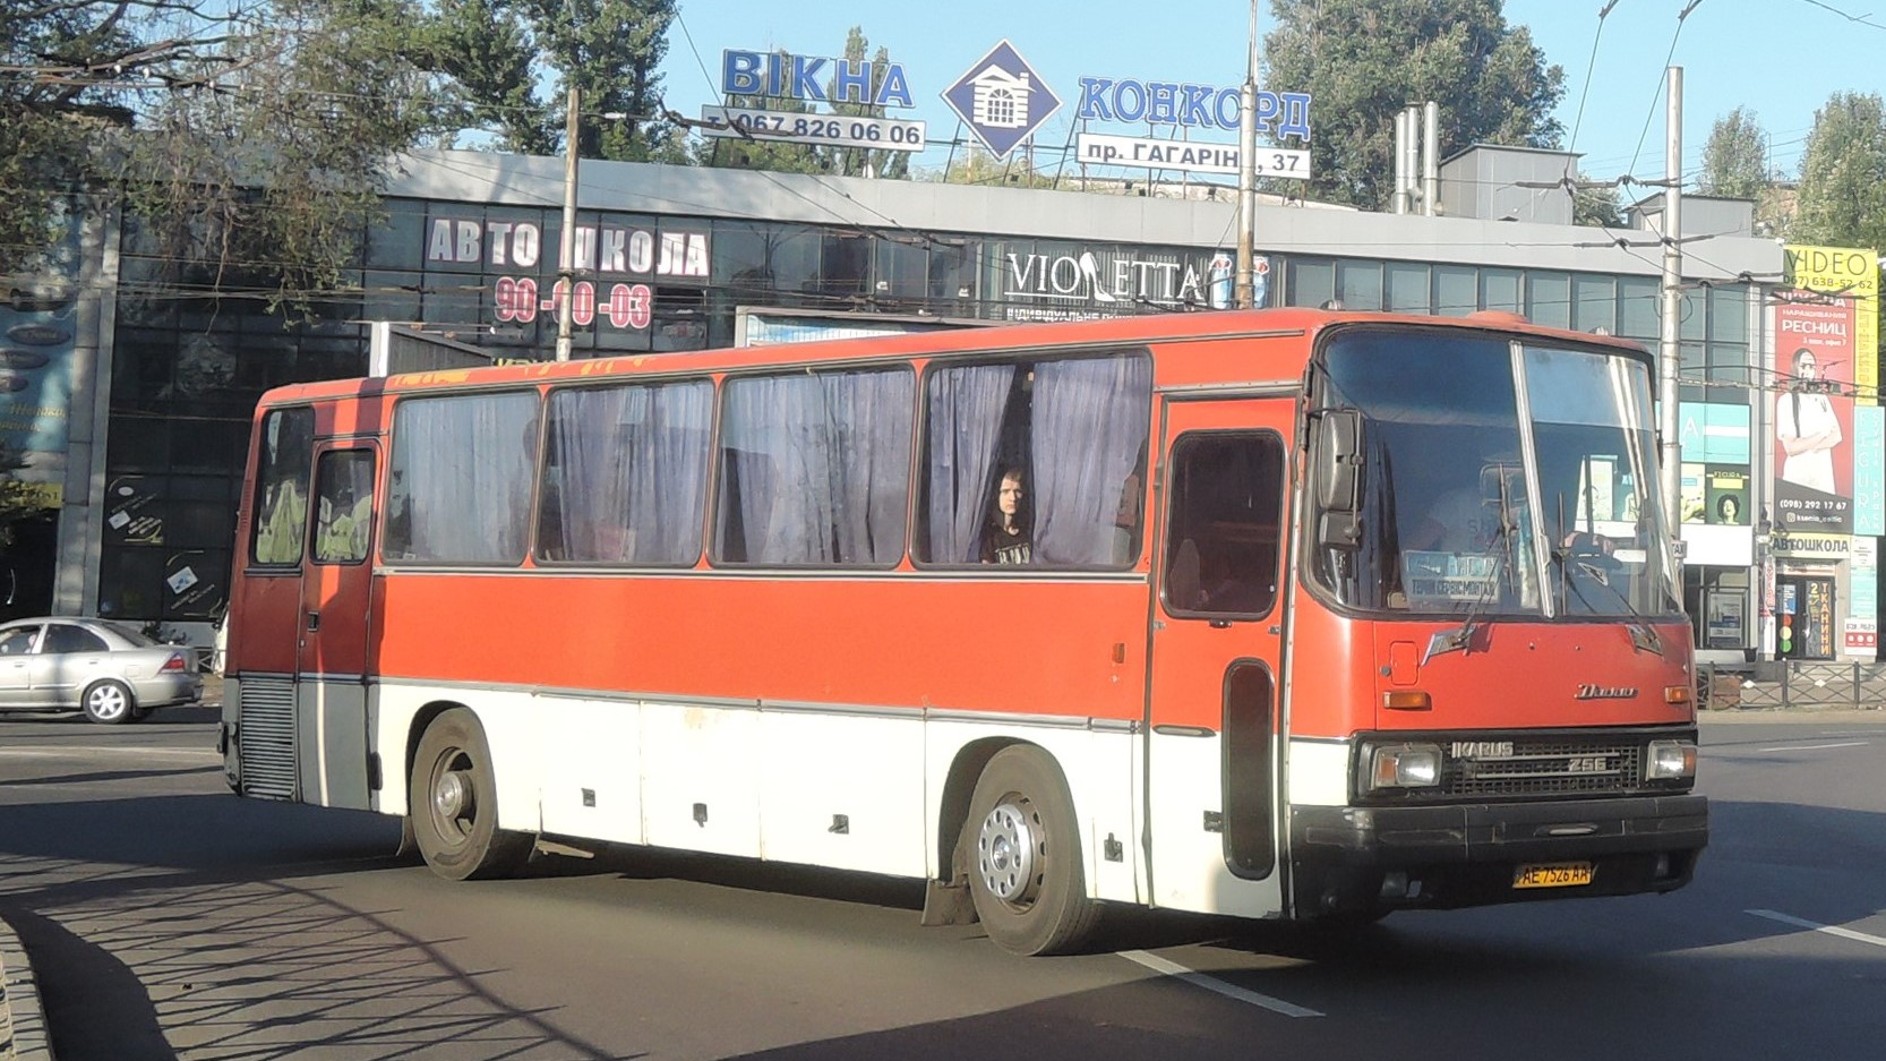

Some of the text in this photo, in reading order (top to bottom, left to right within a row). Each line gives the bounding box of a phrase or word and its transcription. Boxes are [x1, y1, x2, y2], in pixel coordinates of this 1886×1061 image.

[722, 49, 916, 108] ВІКНА
[1079, 77, 1311, 142] КОНКОРД
[794, 118, 841, 138] 826
[850, 122, 881, 142] 06
[889, 125, 920, 144] 06
[1087, 143, 1300, 173] пр. ГАГАРІН, 37
[429, 218, 540, 267] АВТО
[1785, 249, 1867, 275] VIDEO
[1782, 320, 1847, 337] РЕСНИЦ
[1780, 499, 1847, 510] (098) 292 17 67
[1773, 538, 1849, 552] АВТОШКОЛА
[1820, 582, 1832, 656] ТКАНИНИ
[1451, 741, 1514, 758] IKARUS
[1568, 758, 1607, 772] 256
[1540, 865, 1570, 883] 7526
